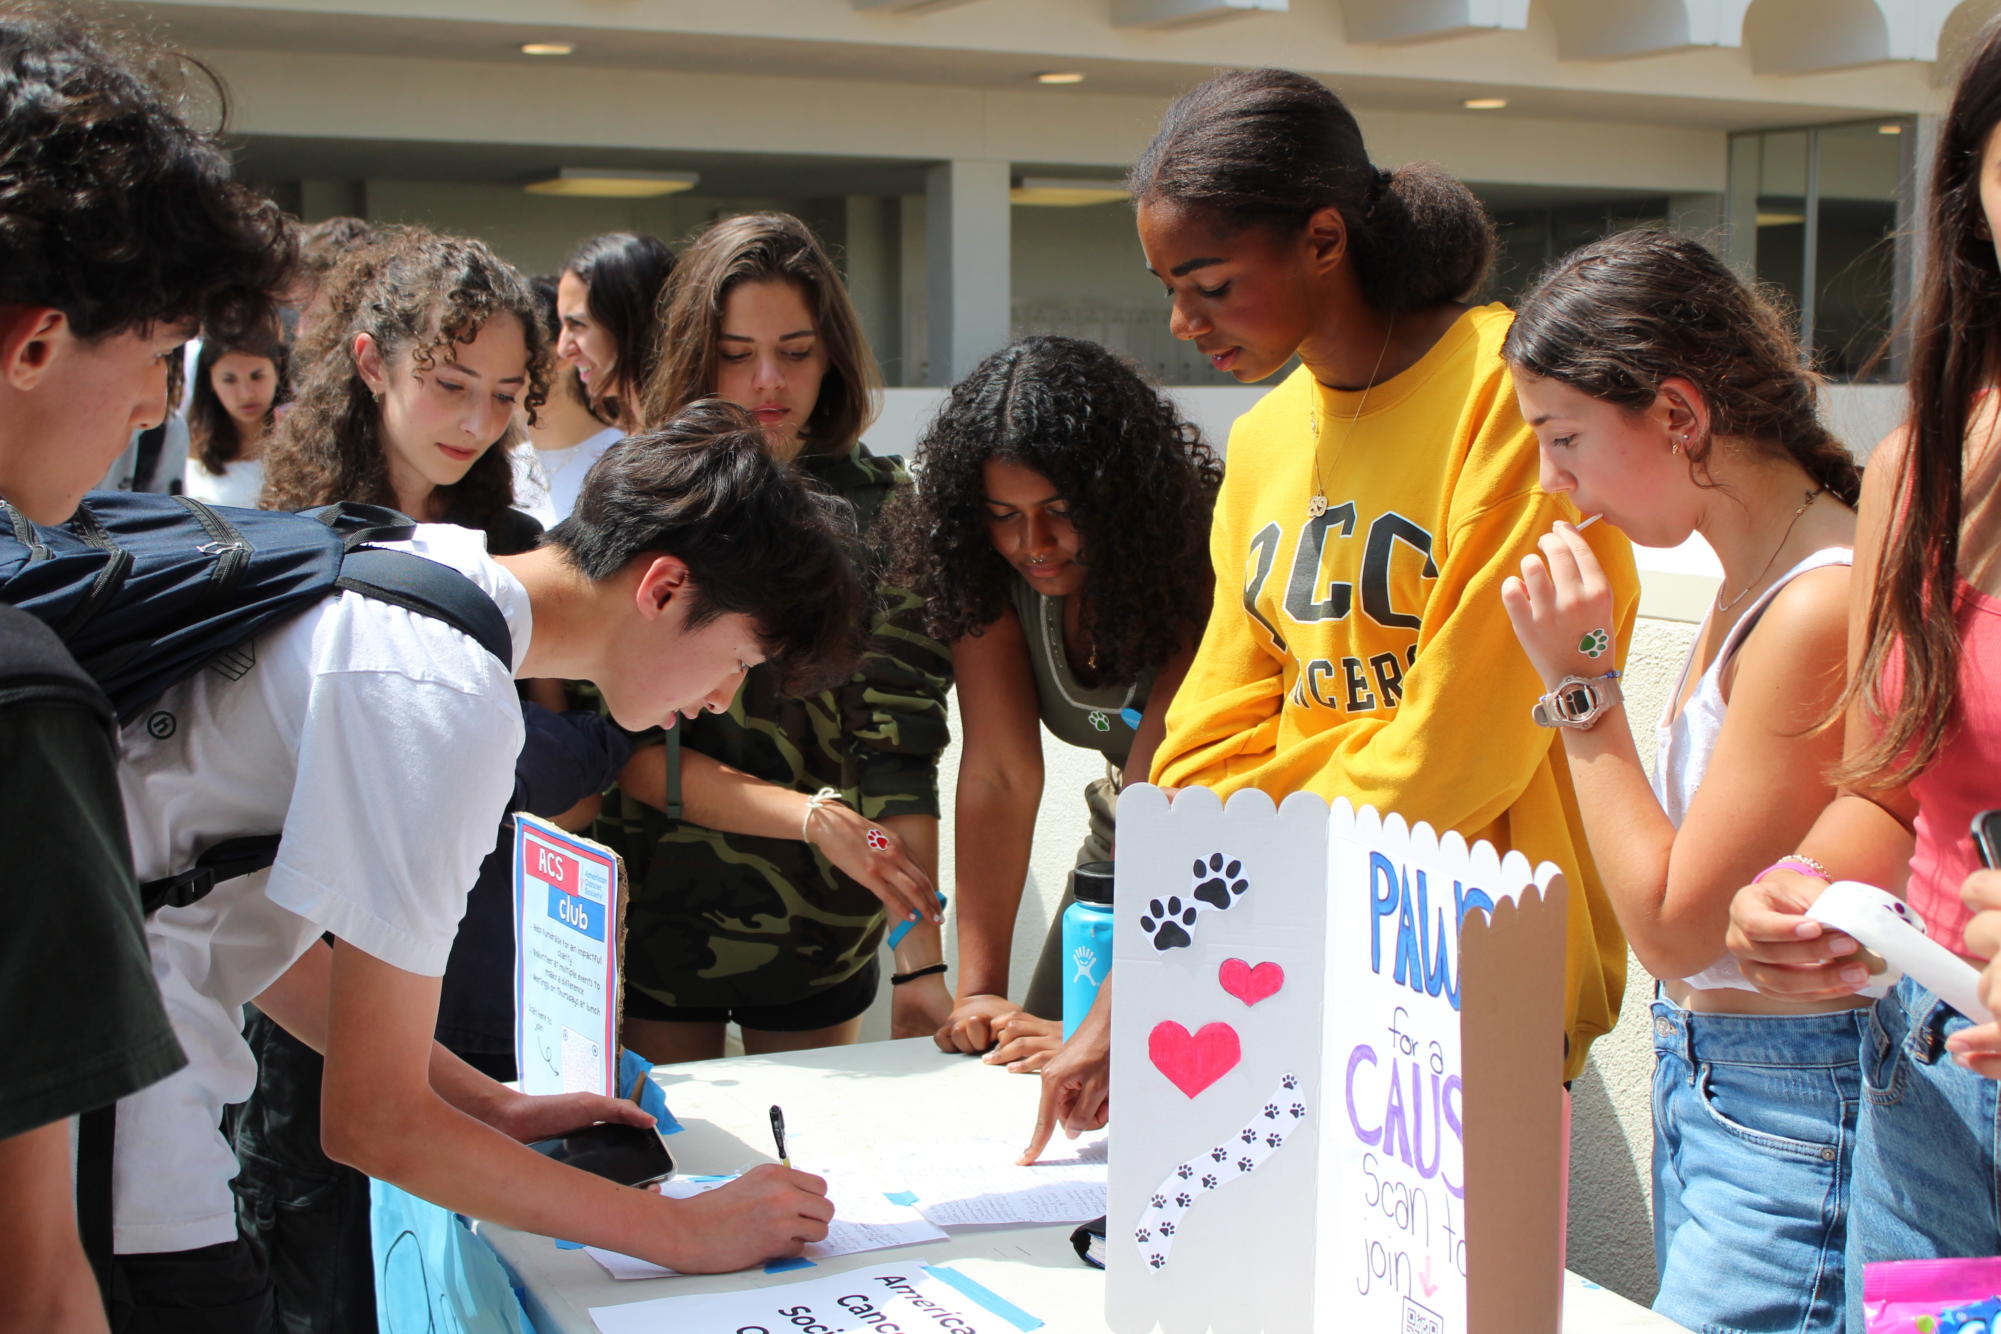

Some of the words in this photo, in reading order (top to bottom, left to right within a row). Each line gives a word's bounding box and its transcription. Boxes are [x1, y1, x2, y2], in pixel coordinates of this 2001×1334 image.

[538, 847, 564, 882] ACS
[559, 894, 589, 931] club
[1369, 850, 1495, 1012] PAW
[1388, 1006, 1419, 1057] for
[1429, 1039, 1444, 1075] a
[1361, 1151, 1430, 1249] Scan
[1356, 1217, 1412, 1299] join
[836, 1294, 907, 1334] Canc
